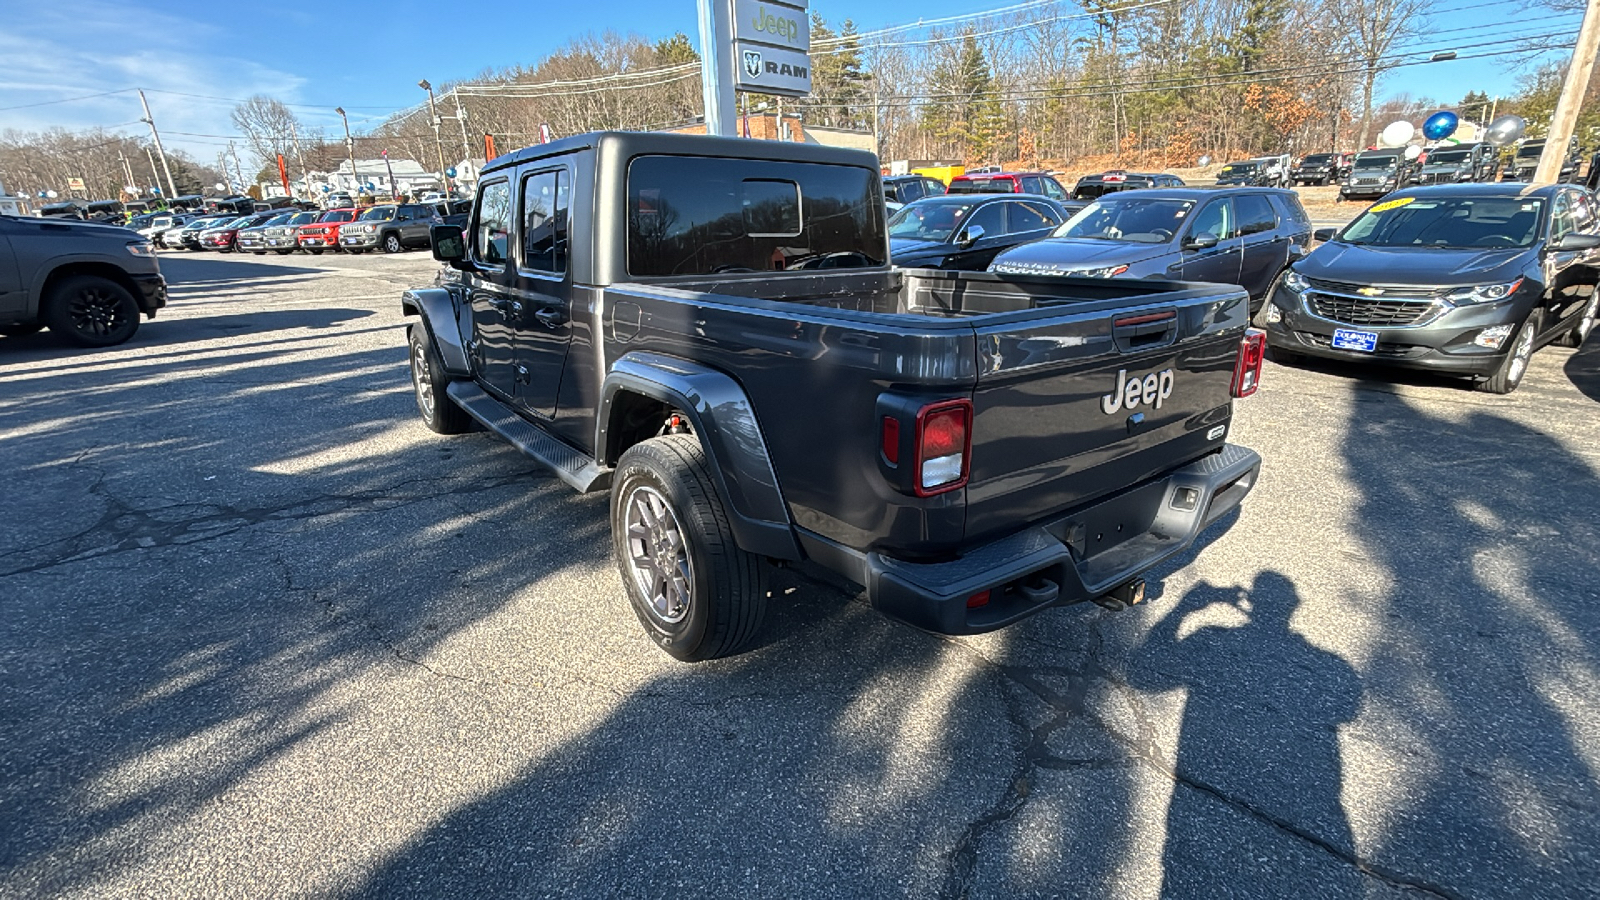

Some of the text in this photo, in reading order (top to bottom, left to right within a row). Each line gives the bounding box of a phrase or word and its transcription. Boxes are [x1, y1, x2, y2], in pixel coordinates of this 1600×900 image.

[752, 6, 798, 43] Jeep
[765, 61, 808, 79] RAM
[1101, 368, 1174, 415] Jeep
